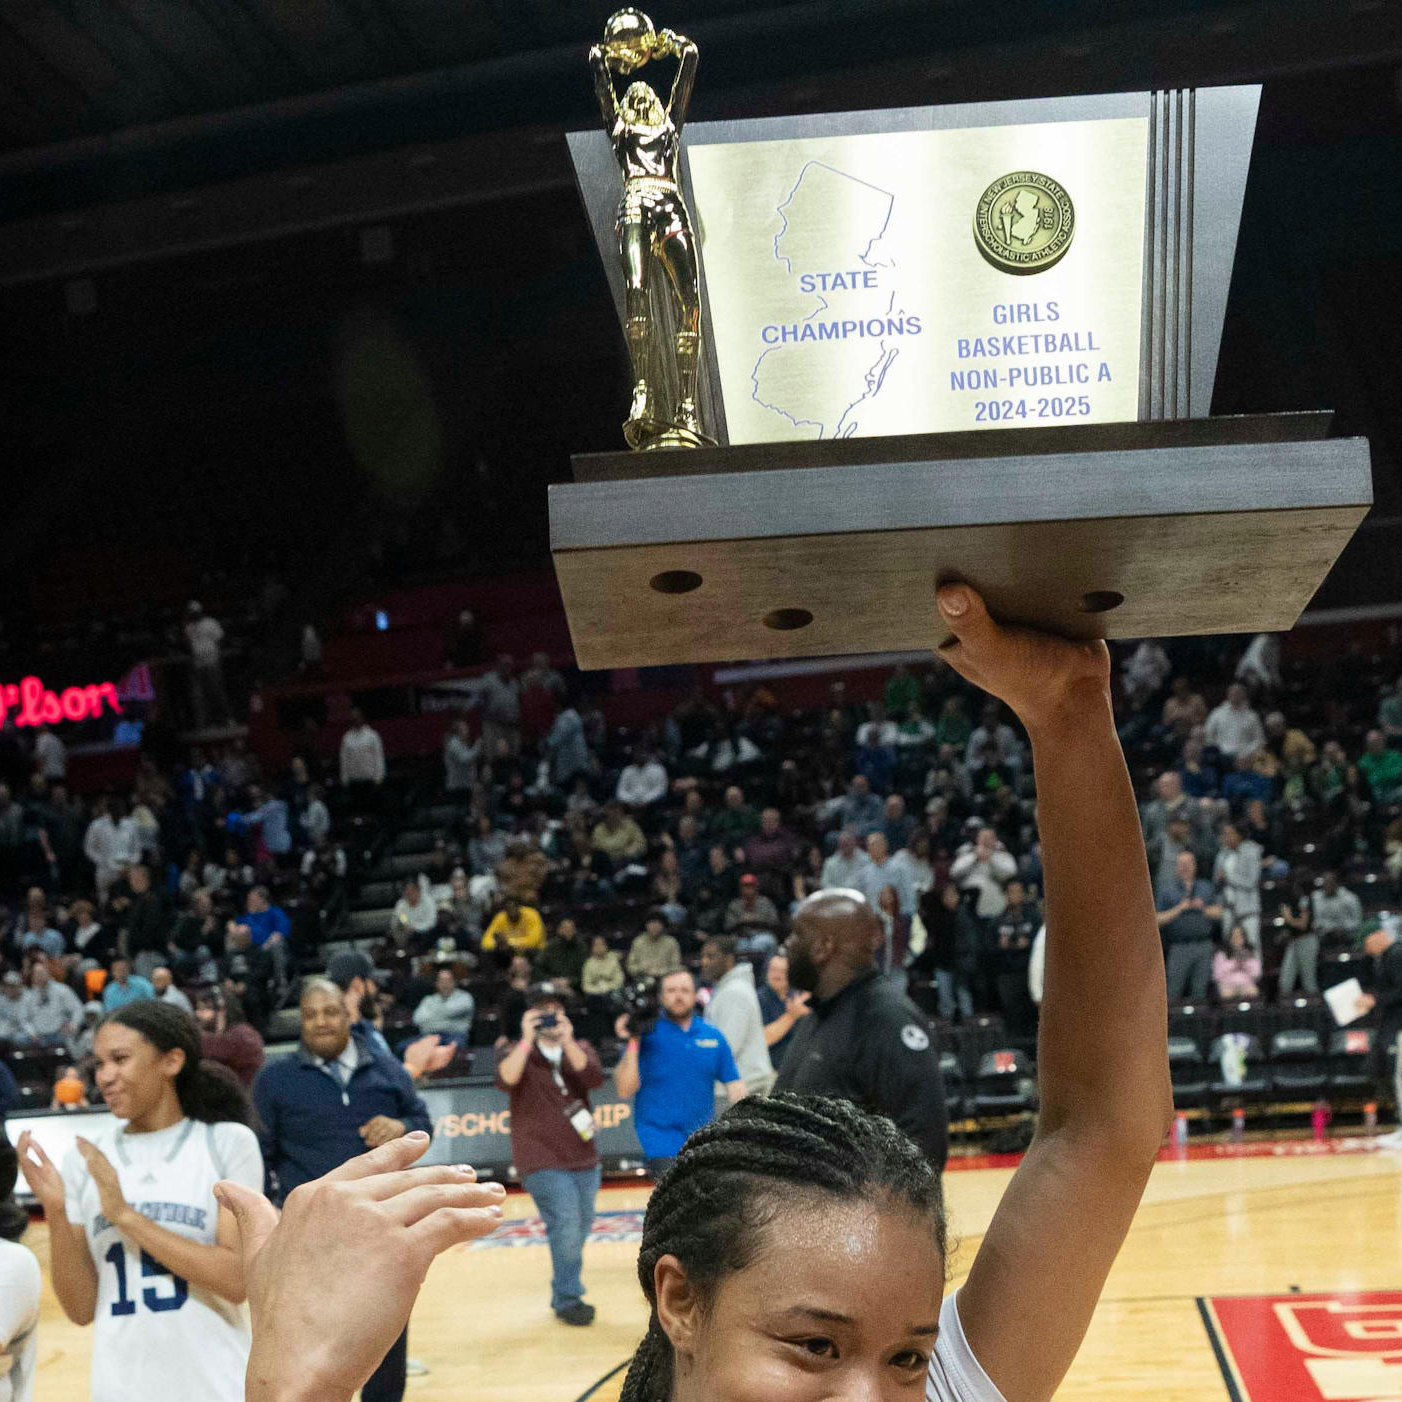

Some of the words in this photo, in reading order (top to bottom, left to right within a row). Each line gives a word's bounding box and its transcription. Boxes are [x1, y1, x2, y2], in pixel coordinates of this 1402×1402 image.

[1002, 174, 1039, 189] JERSEY
[1039, 177, 1065, 200] STATE
[1043, 207, 1055, 229] 1918
[799, 270, 878, 293] STATE
[992, 301, 1060, 325] GIRLS
[761, 315, 922, 345] CHAMPIONS
[957, 331, 1101, 359] BASKETBALL
[950, 363, 1090, 391] NON-PUBLIC
[1097, 362, 1112, 382] A
[974, 395, 1091, 422] 2024-2025
[105, 1240, 190, 1317] 15
